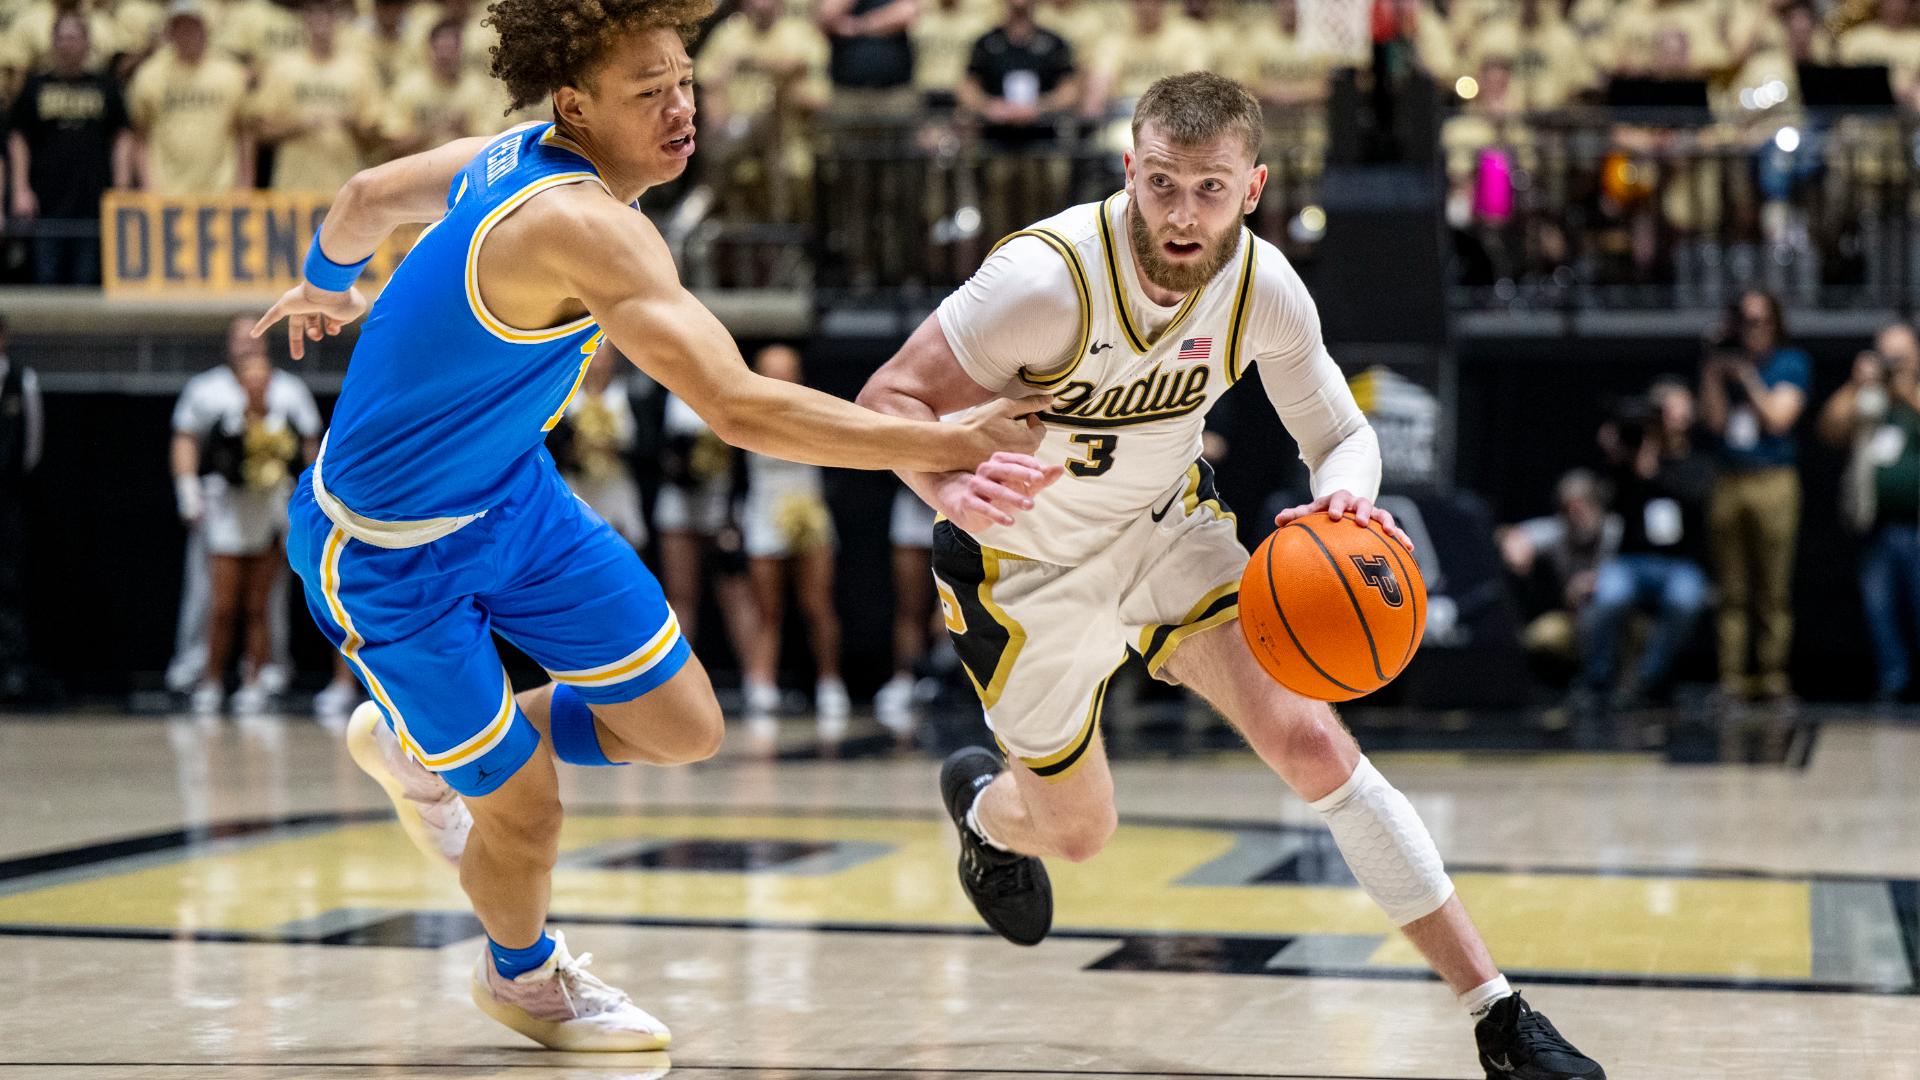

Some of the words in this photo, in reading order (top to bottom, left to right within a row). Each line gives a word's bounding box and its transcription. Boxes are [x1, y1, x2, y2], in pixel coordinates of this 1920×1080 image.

[486, 133, 523, 188] PERRY
[115, 206, 378, 282] DEFEN
[1050, 364, 1210, 418] Purdue
[1064, 433, 1119, 477] 3
[1349, 554, 1404, 608] P
